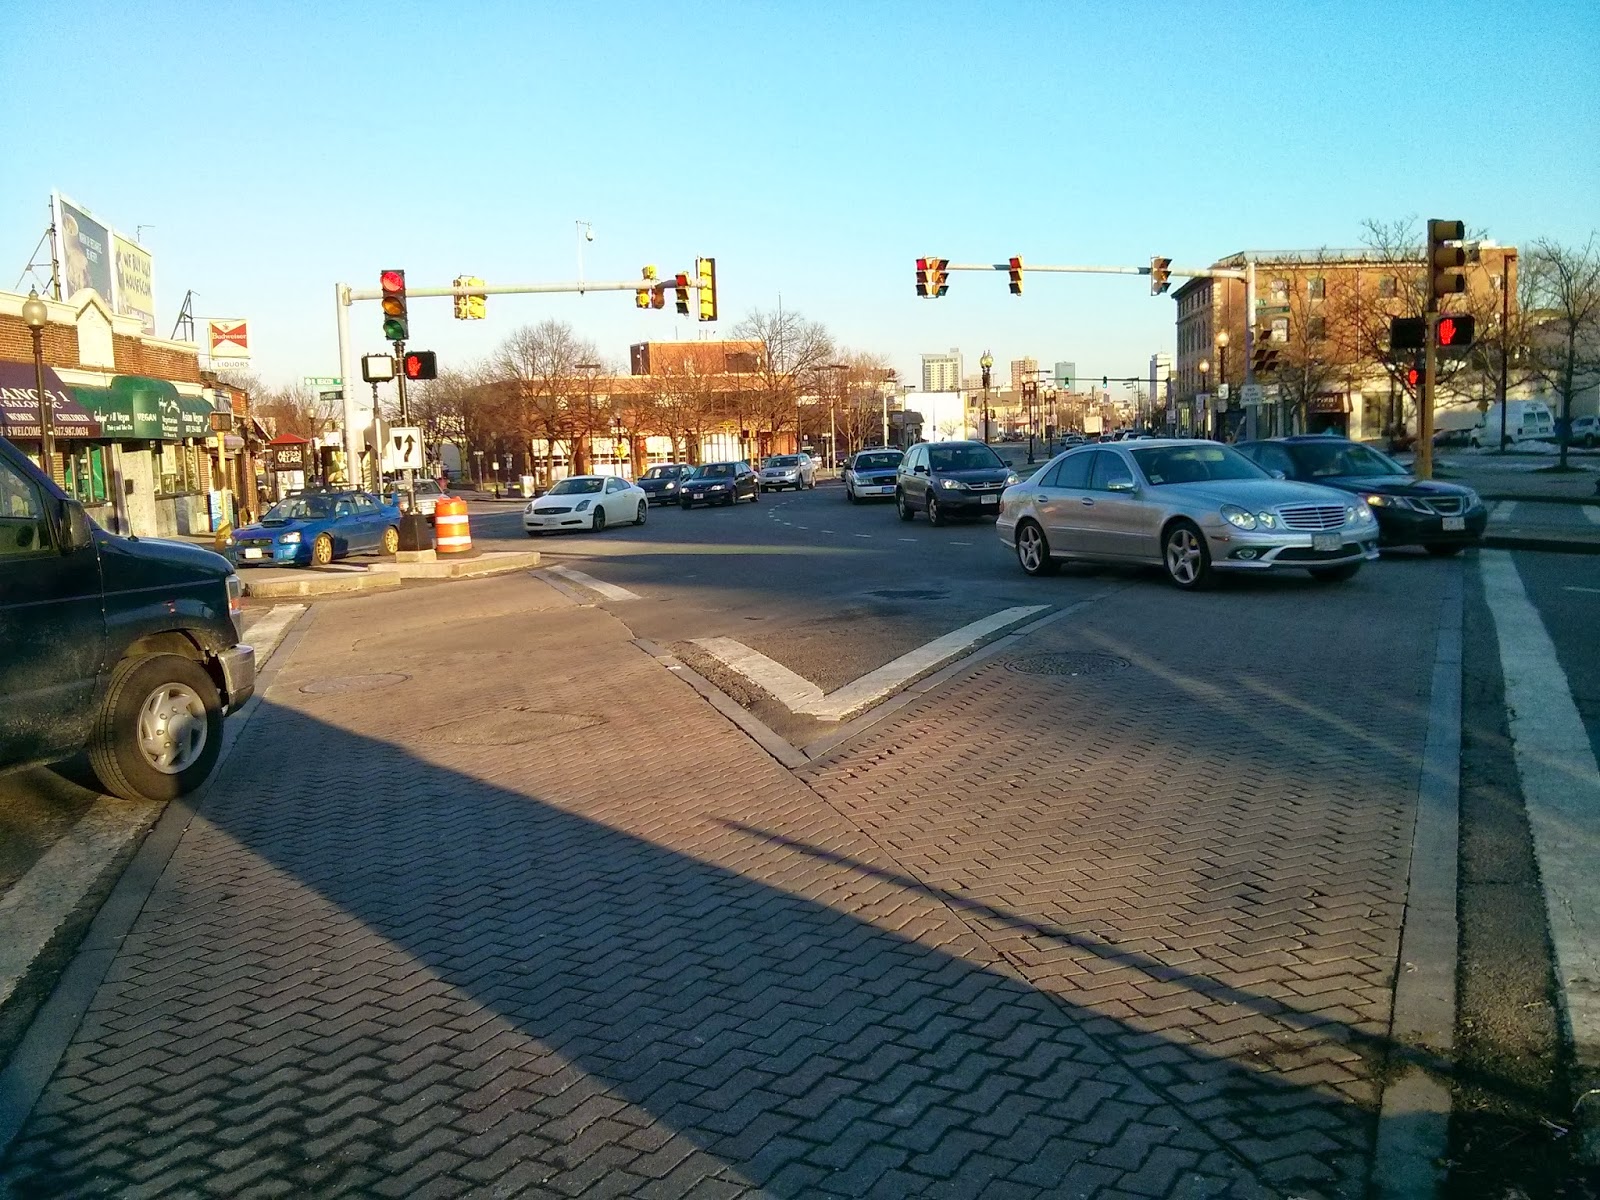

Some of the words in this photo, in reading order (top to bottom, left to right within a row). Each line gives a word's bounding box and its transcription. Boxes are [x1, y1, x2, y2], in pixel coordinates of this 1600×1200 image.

[211, 332, 247, 340] Budweiser
[4, 400, 40, 408] SALON
[6, 413, 36, 421] WOMEN
[56, 413, 90, 422] CHILDREN
[137, 413, 157, 422] VEGAN
[12, 426, 42, 437] WELCOME
